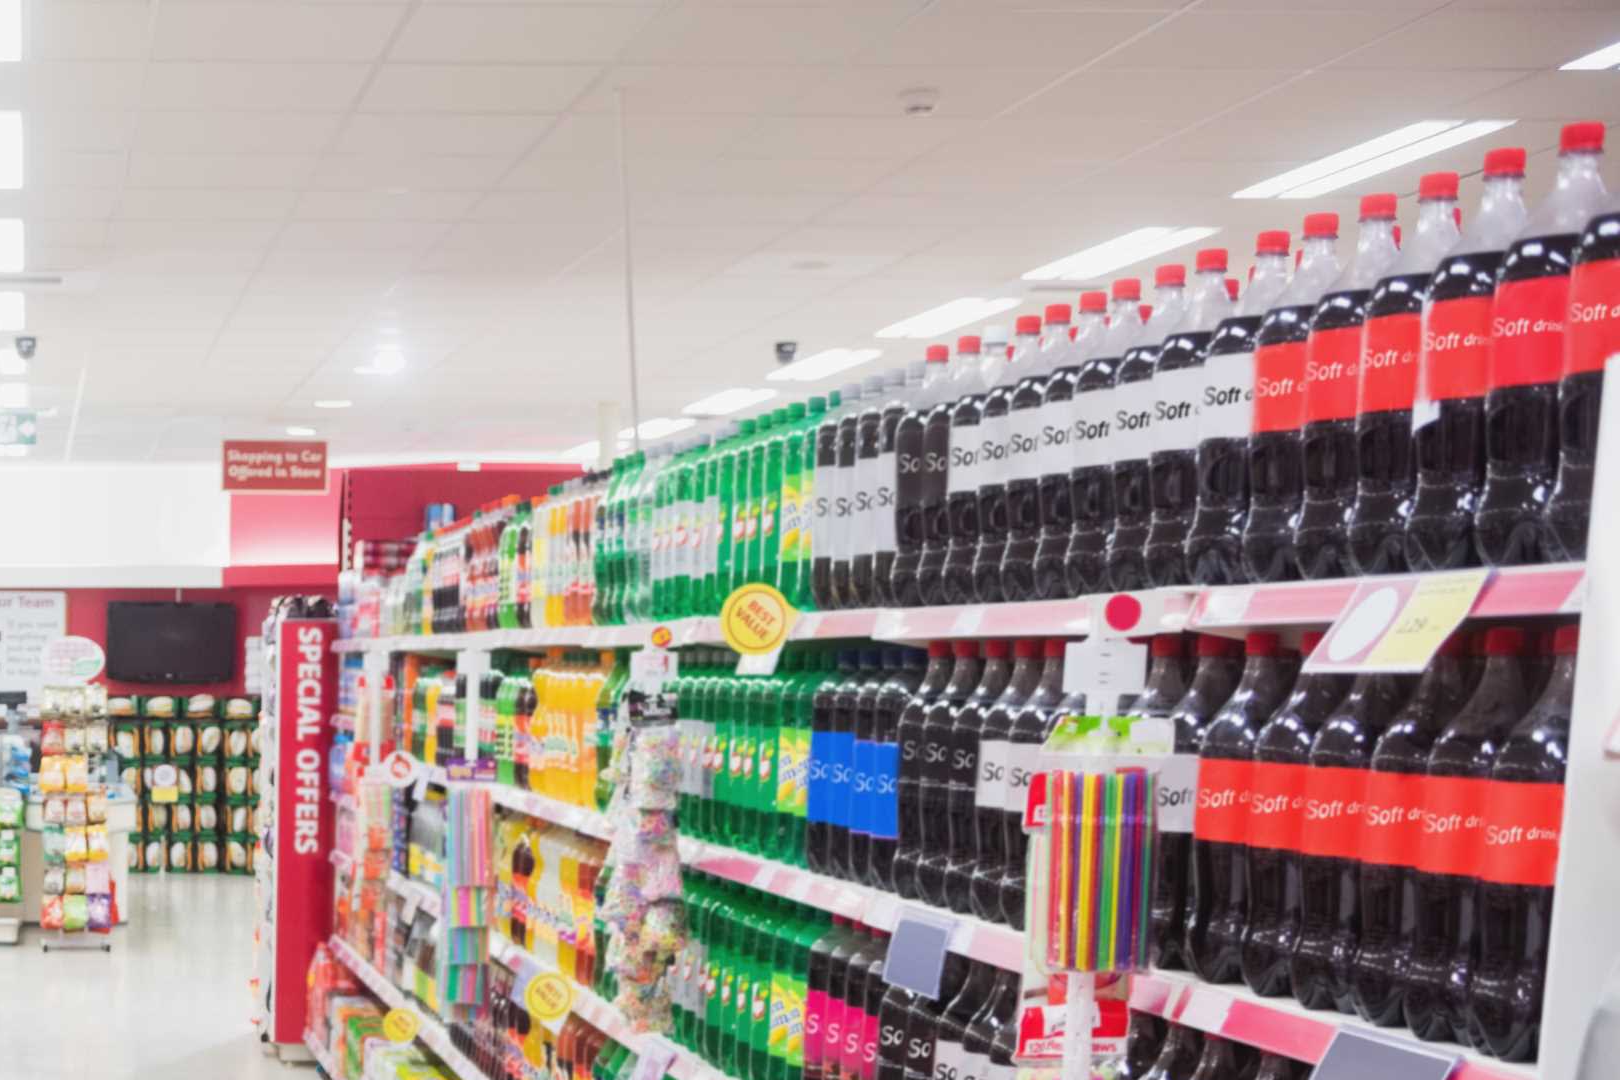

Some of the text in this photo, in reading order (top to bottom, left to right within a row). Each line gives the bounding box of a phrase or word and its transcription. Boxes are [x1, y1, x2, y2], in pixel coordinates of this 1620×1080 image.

[1570, 302, 1608, 323] Soft
[1493, 318, 1529, 338] Soft
[1423, 331, 1460, 351] Soft
[1363, 349, 1398, 370] Soft
[1306, 361, 1343, 381] Soft
[1203, 386, 1241, 405] Soft
[1256, 377, 1292, 397] Soft
[1155, 401, 1191, 421] Soft
[227, 449, 322, 465] Shopping to Car
[228, 465, 272, 481] Offered
[290, 464, 320, 478] Store
[19, 596, 55, 608] Team
[748, 600, 775, 624] BEST
[736, 607, 766, 639] VALUE
[294, 627, 323, 855] SPECIAL OFFERS
[1198, 788, 1234, 808] Soft
[1252, 793, 1289, 814] Soft
[1306, 799, 1343, 820] Soft
[1366, 804, 1403, 826] Soft
[1423, 812, 1462, 833] Soft
[1485, 824, 1524, 846] Soft
